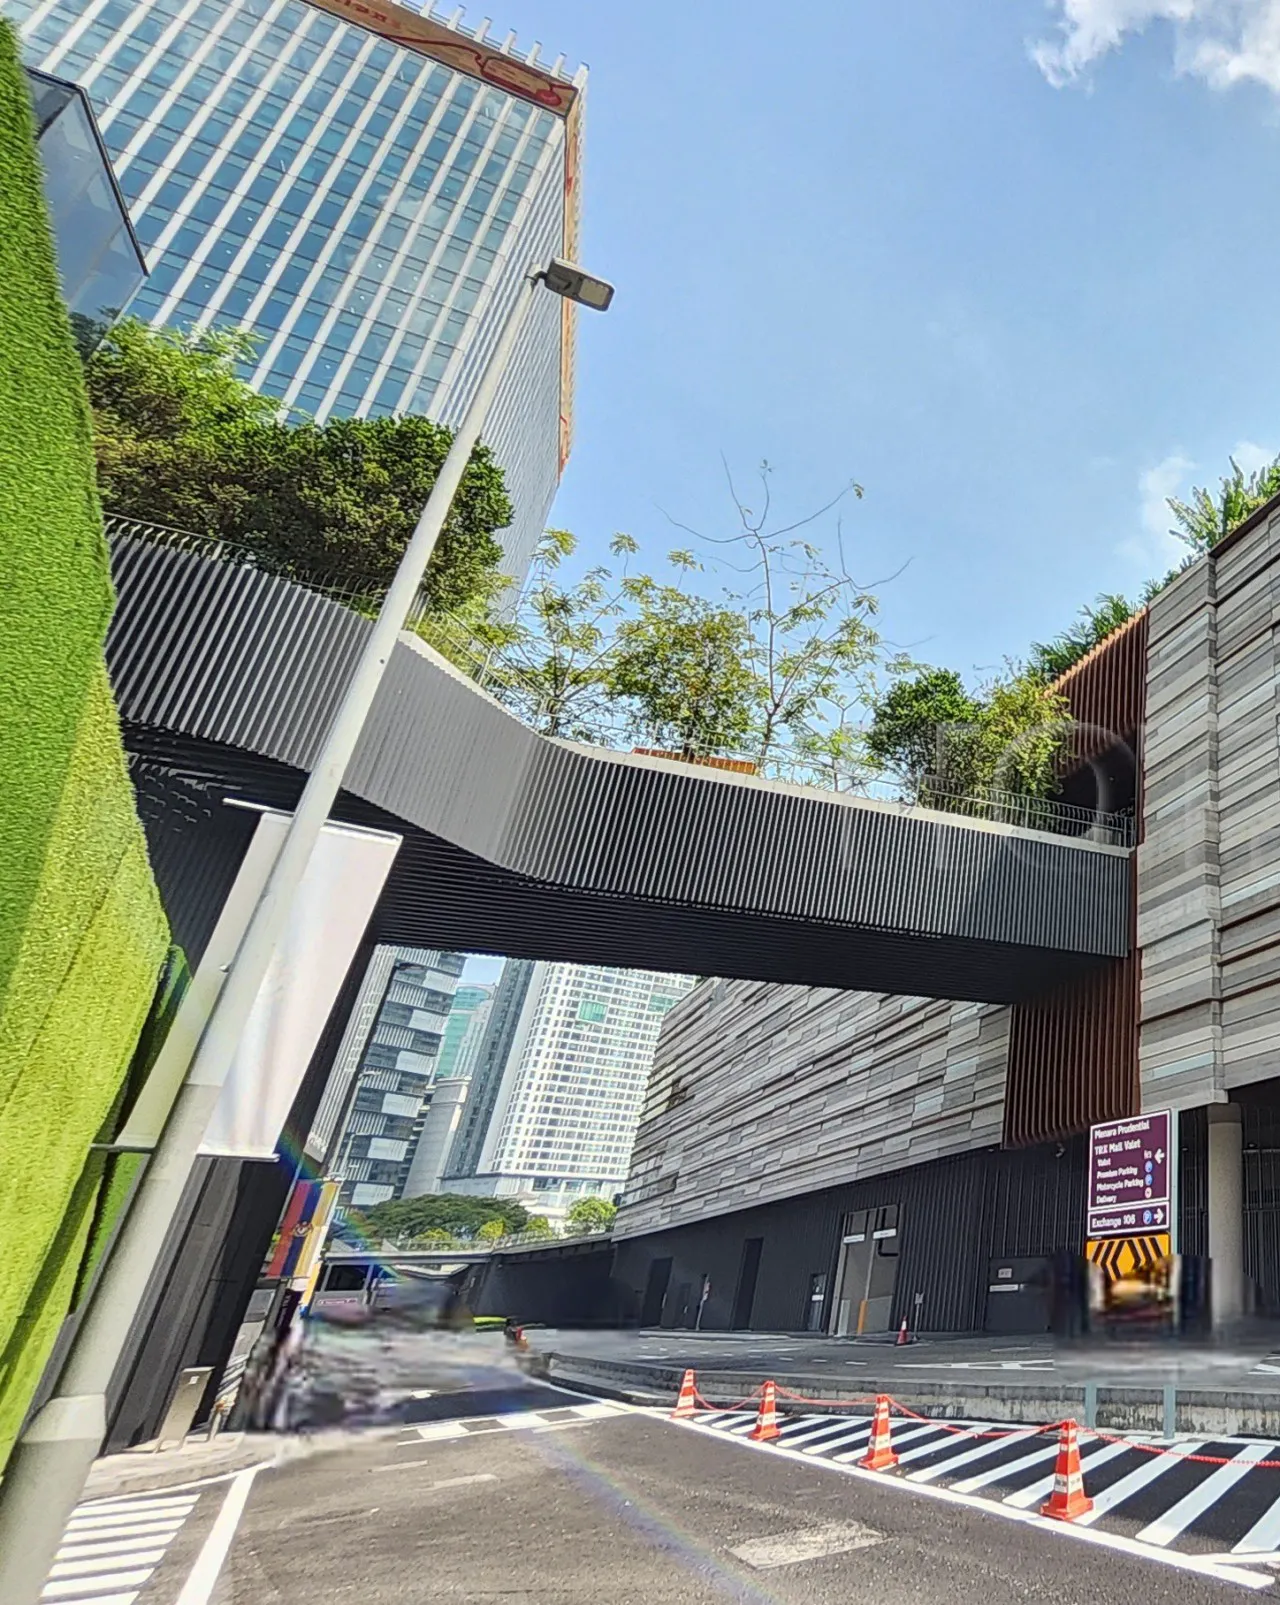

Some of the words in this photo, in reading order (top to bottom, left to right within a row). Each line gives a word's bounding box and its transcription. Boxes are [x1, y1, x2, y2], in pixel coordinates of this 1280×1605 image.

[1118, 1120, 1150, 1135] Prudential
[1094, 1144, 1108, 1155] TRX
[1109, 1142, 1123, 1153] Mall
[1124, 1138, 1141, 1150] Valet
[1118, 1166, 1138, 1176] Parking
[1096, 1181, 1123, 1192] Motorcycle
[1124, 1178, 1144, 1188] Parking
[1096, 1194, 1117, 1204] Delivery
[1091, 1217, 1121, 1229] Exchange
